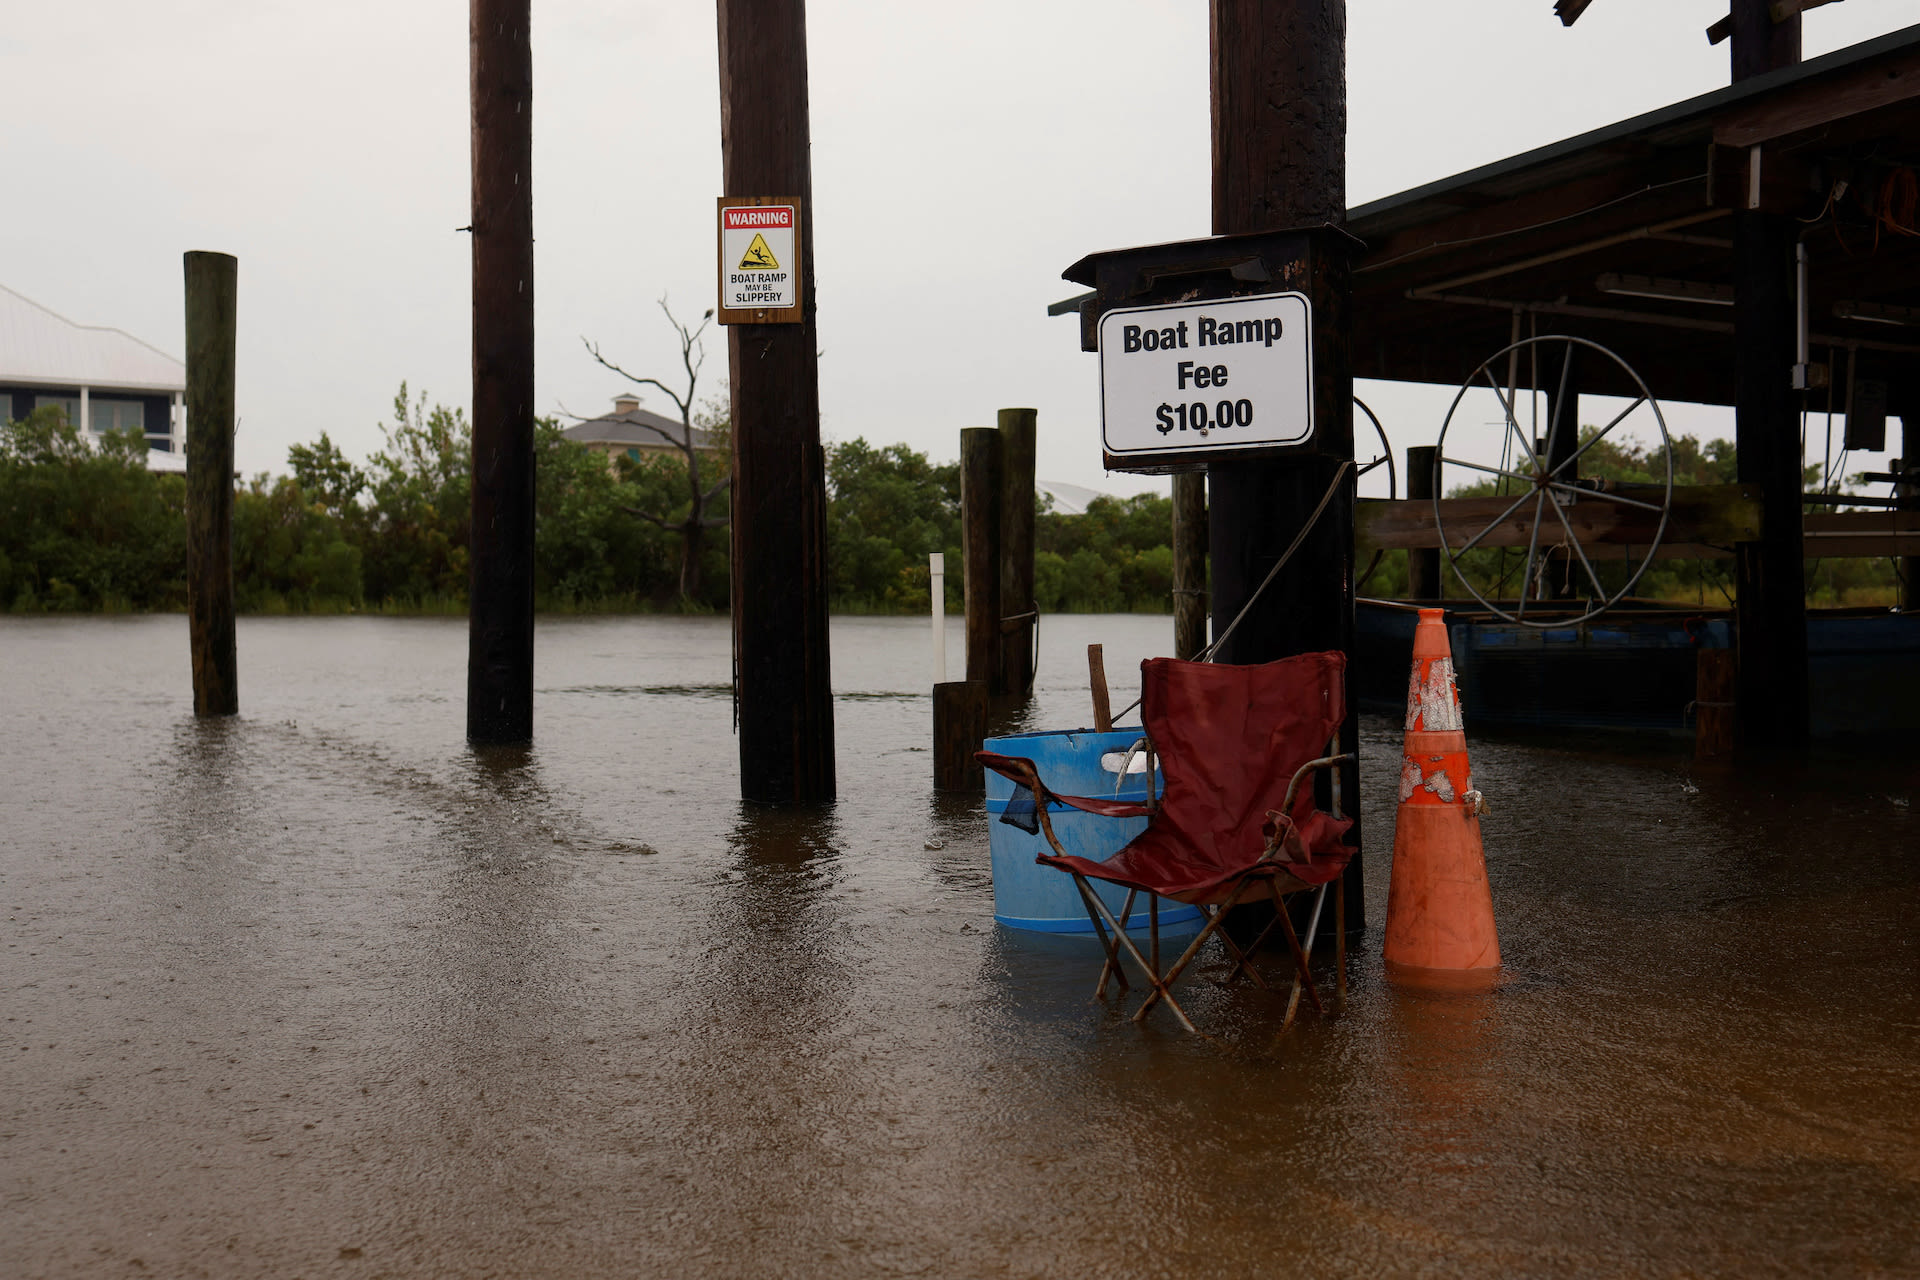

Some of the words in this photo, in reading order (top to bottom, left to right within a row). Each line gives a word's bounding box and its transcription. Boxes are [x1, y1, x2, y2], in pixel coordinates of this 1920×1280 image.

[729, 212, 788, 225] WARNING
[731, 274, 756, 283] BOAT
[758, 273, 787, 283] RAMP
[736, 293, 782, 302] SLIPPERY
[1123, 321, 1188, 353] Boat
[1198, 317, 1283, 347] Ramp
[1177, 361, 1228, 389] Fee
[1156, 399, 1253, 436] $10.00
